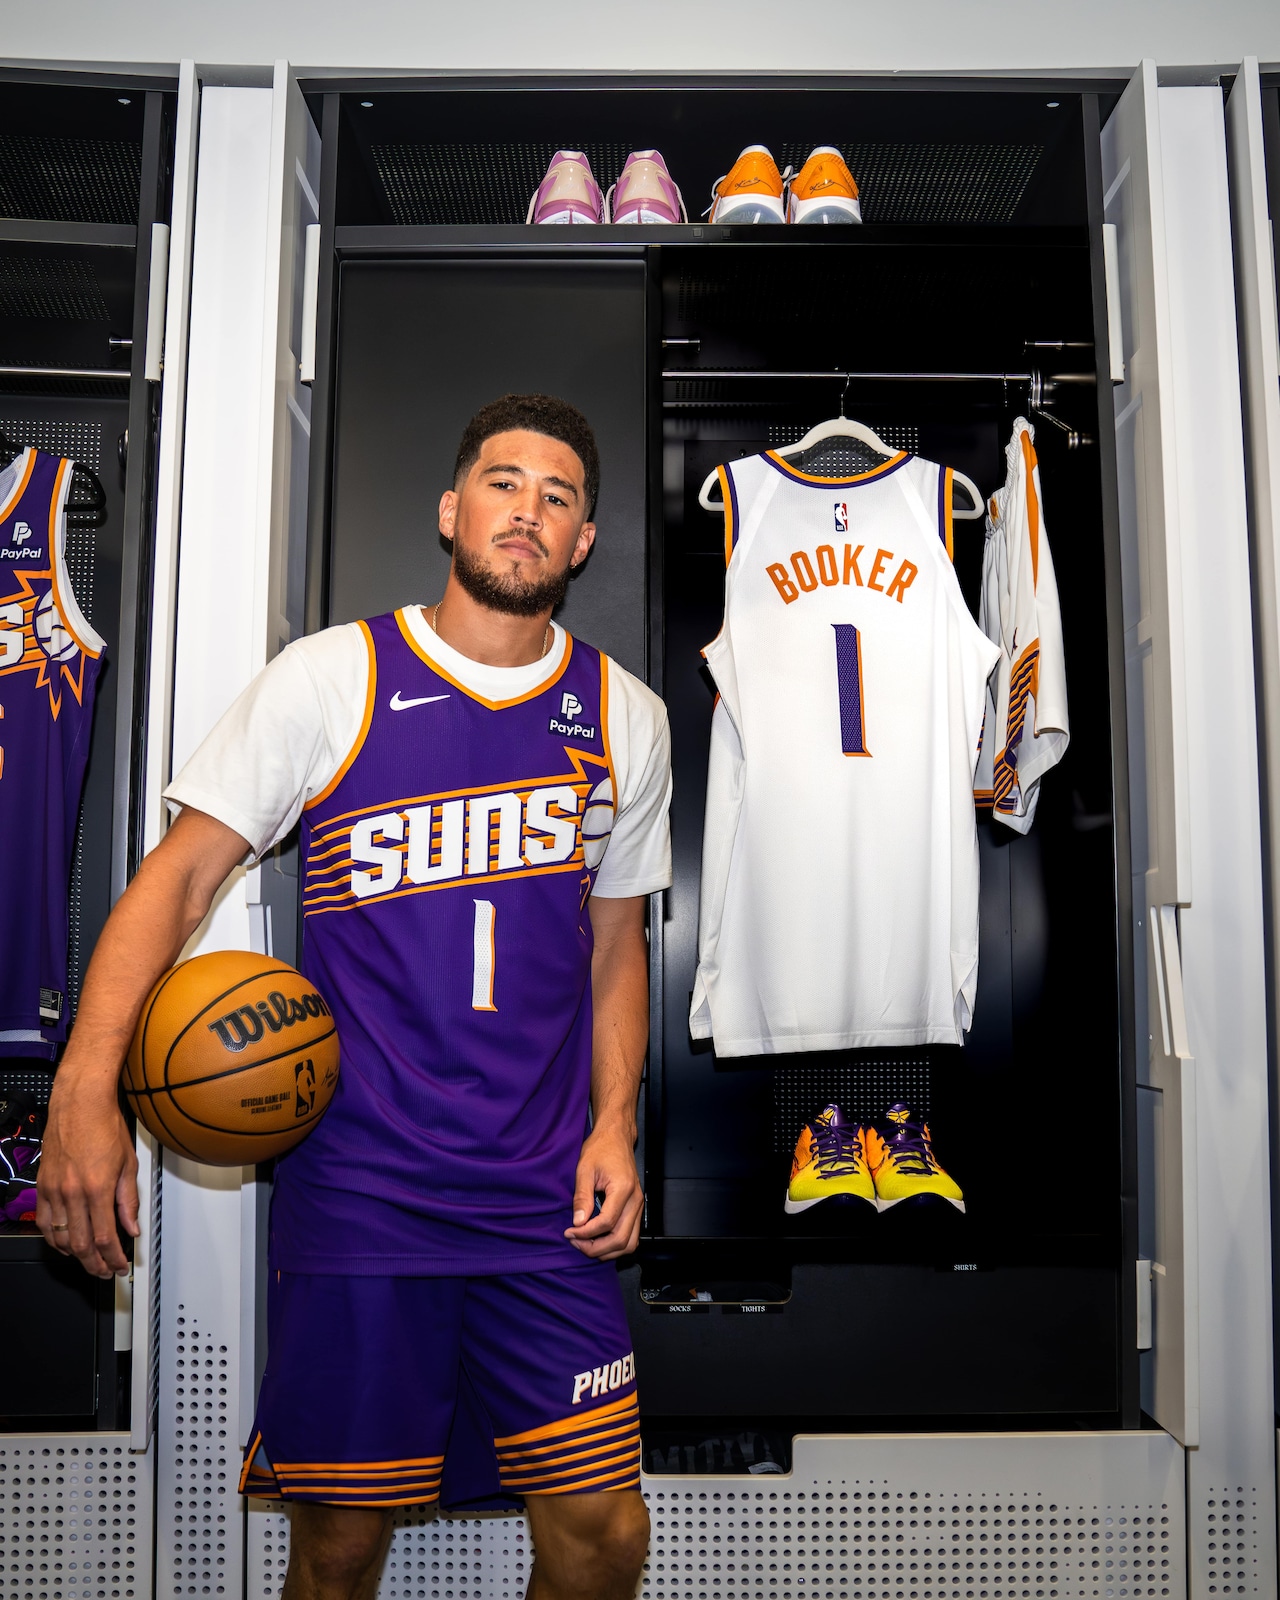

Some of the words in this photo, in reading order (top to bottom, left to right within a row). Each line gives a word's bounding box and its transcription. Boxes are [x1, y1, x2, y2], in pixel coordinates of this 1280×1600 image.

[0, 548, 42, 560] PayPal
[765, 543, 918, 605] BOOKER
[830, 623, 873, 758] 1
[550, 719, 594, 738] PayPal
[350, 785, 577, 898] SUNS
[472, 899, 498, 1012] 1
[207, 991, 331, 1053] Wilson
[953, 1263, 977, 1271] SHIRTS
